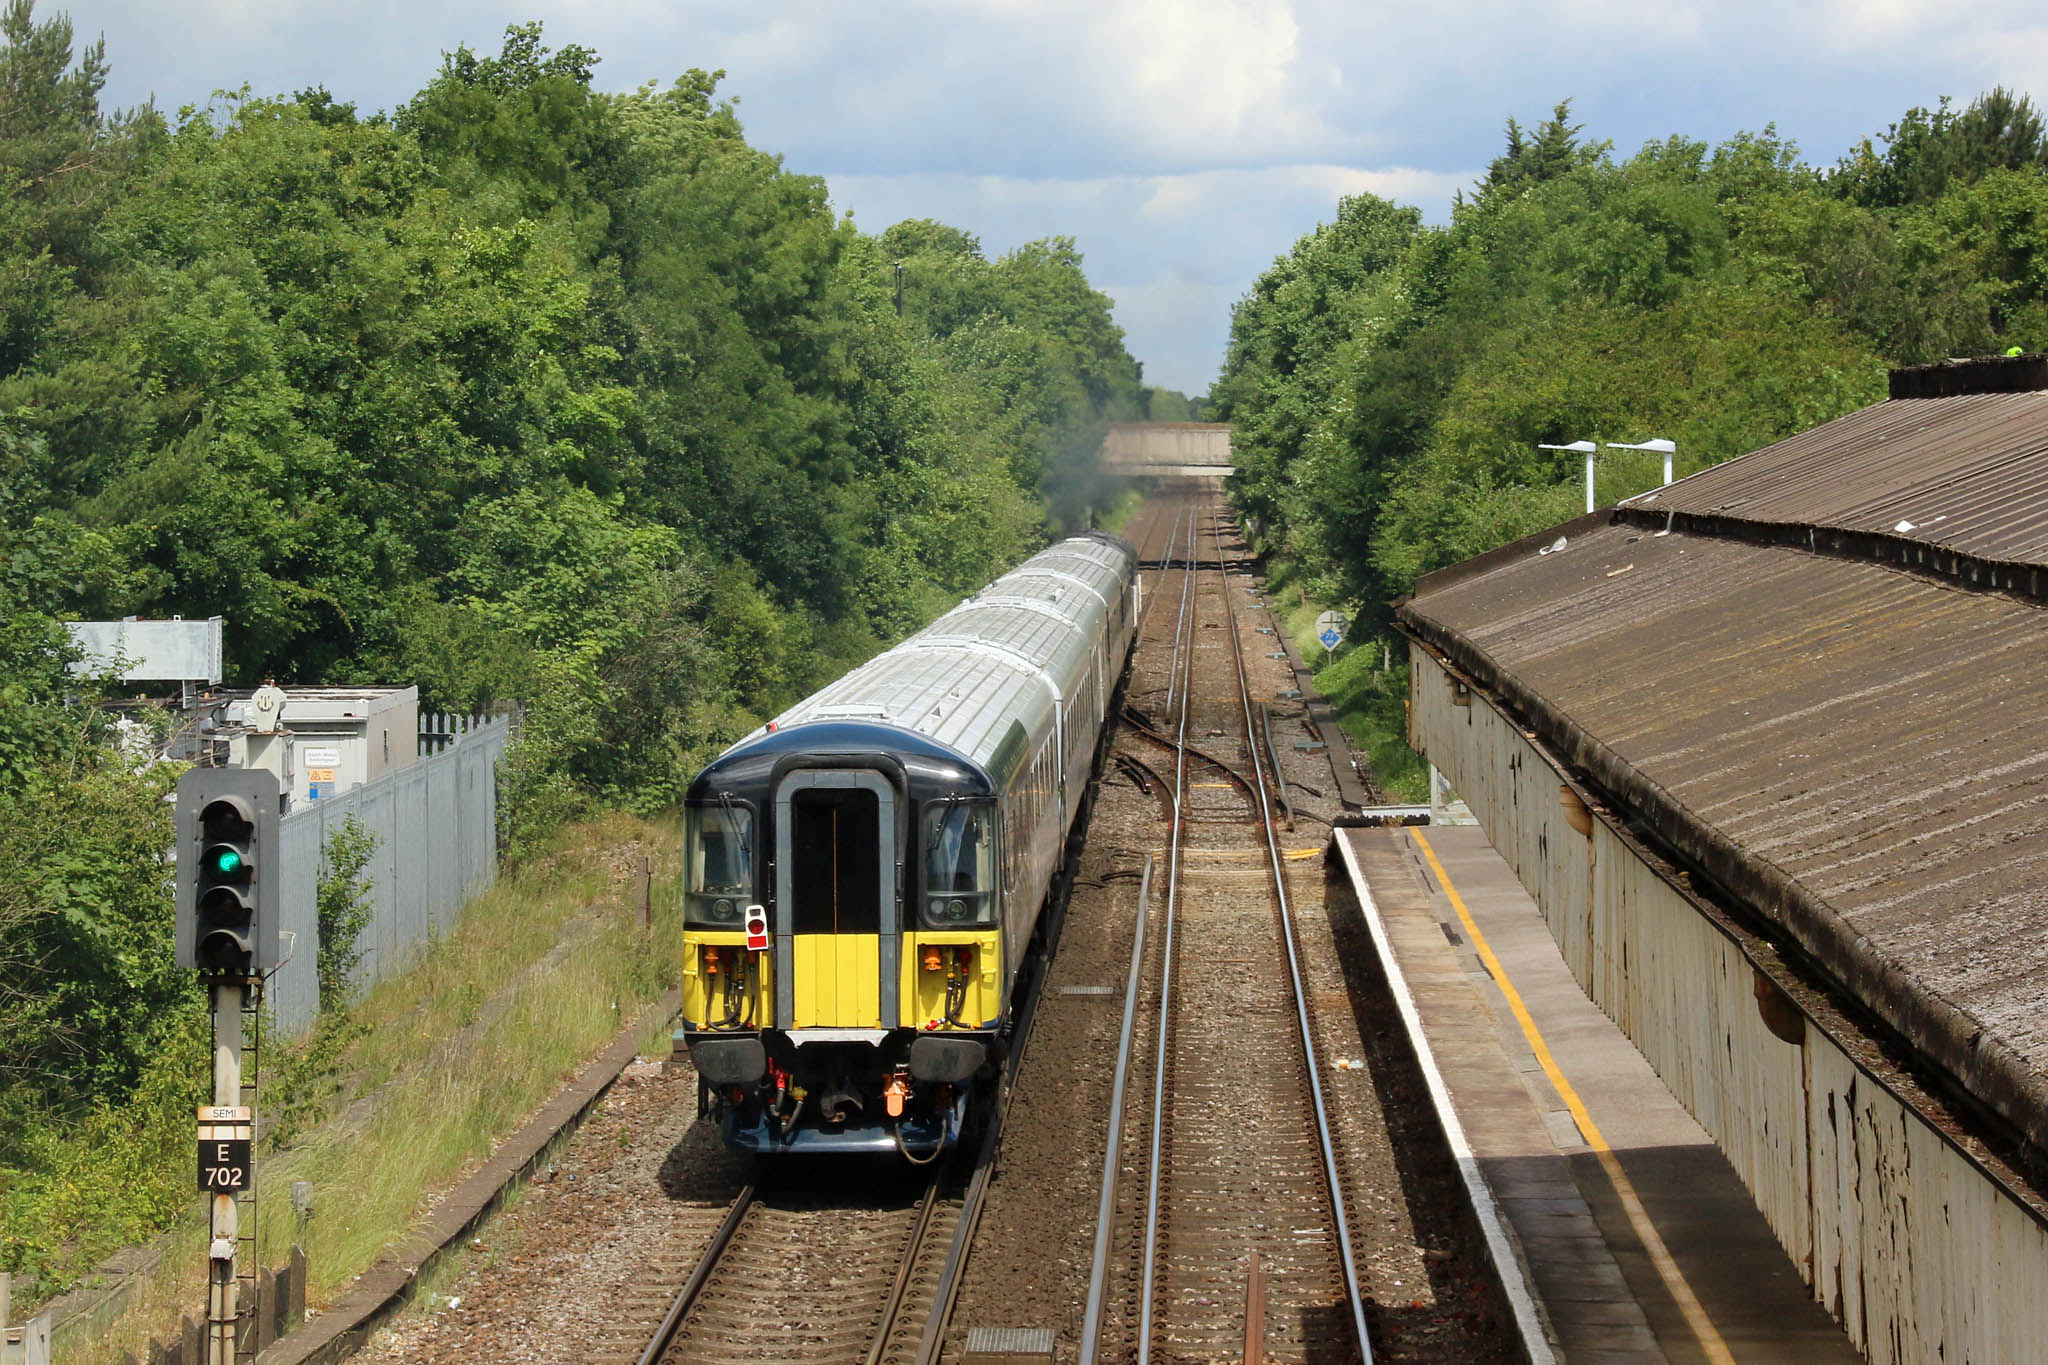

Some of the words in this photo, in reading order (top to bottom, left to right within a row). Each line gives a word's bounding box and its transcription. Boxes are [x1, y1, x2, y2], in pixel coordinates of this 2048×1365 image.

[212, 1109, 237, 1118] SEMI
[217, 1144, 230, 1162] E
[205, 1167, 243, 1186] 702
